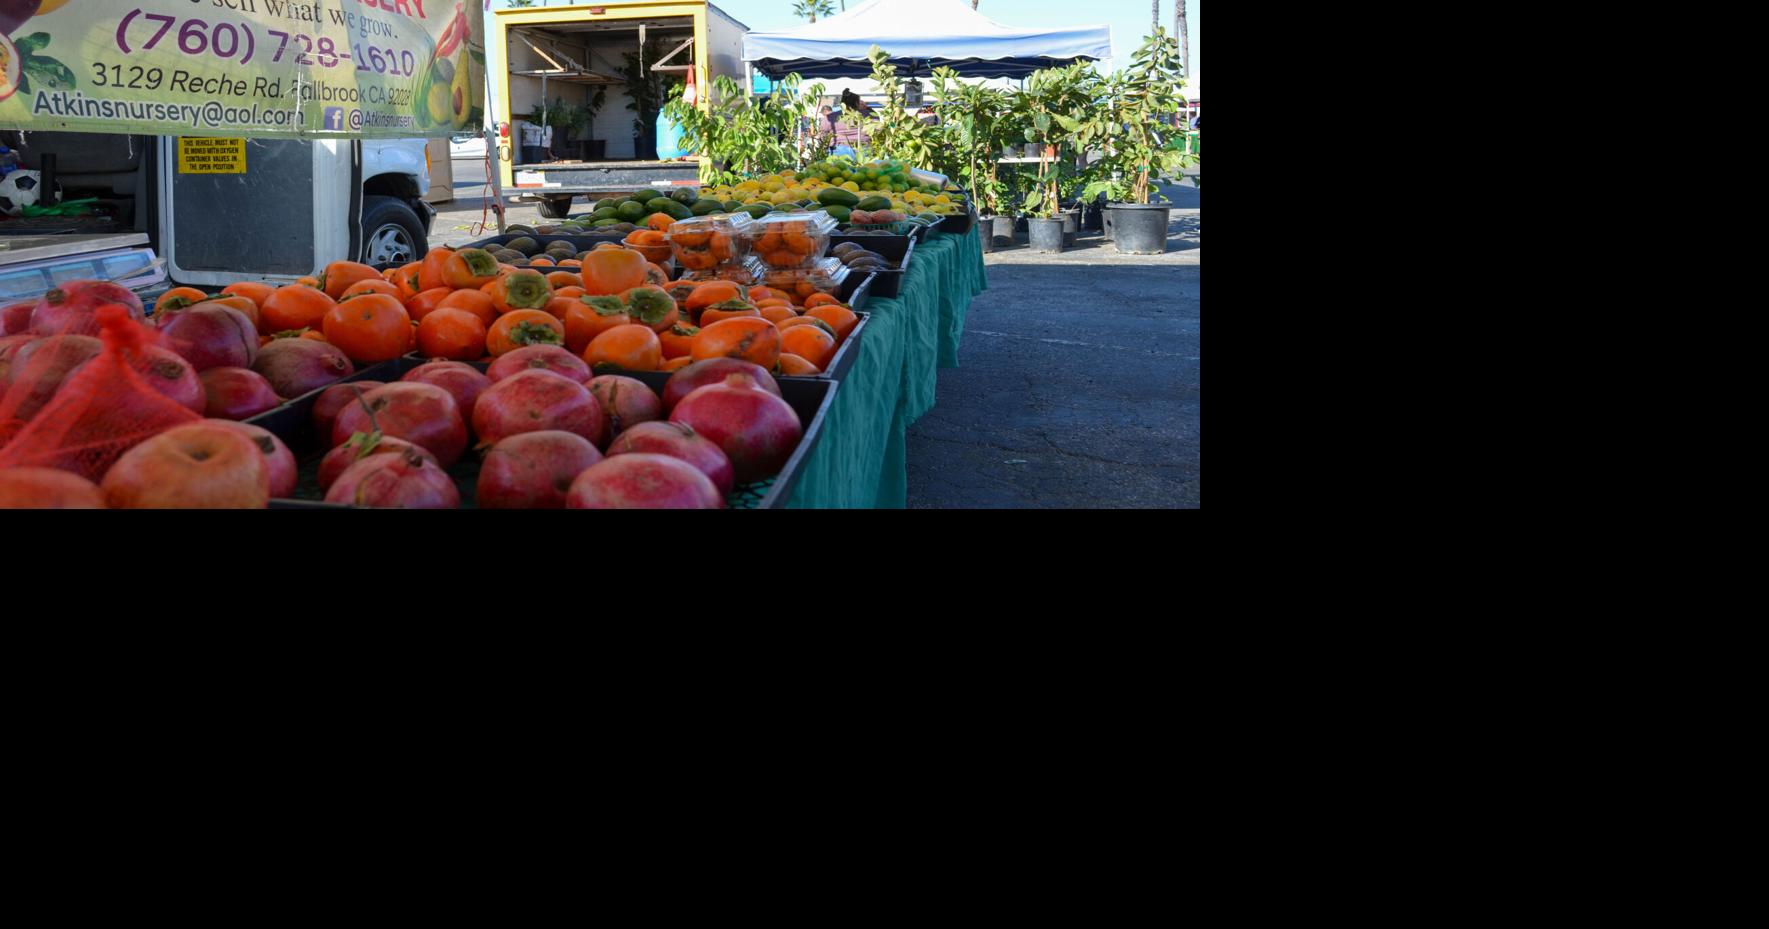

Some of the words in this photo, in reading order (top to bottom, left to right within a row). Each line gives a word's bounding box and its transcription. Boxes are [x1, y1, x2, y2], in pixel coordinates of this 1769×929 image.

[116, 8, 255, 65] (760)
[267, 29, 415, 77] 728-1610
[328, 9, 355, 29] we
[360, 15, 398, 39] grow.
[91, 63, 163, 90] 3129
[170, 70, 247, 97] Reche
[253, 76, 284, 99] Rd.
[368, 85, 386, 104] CA
[33, 90, 304, 127] Atkinsnursery@aol.com
[349, 109, 415, 130] @Atkinsnursery
